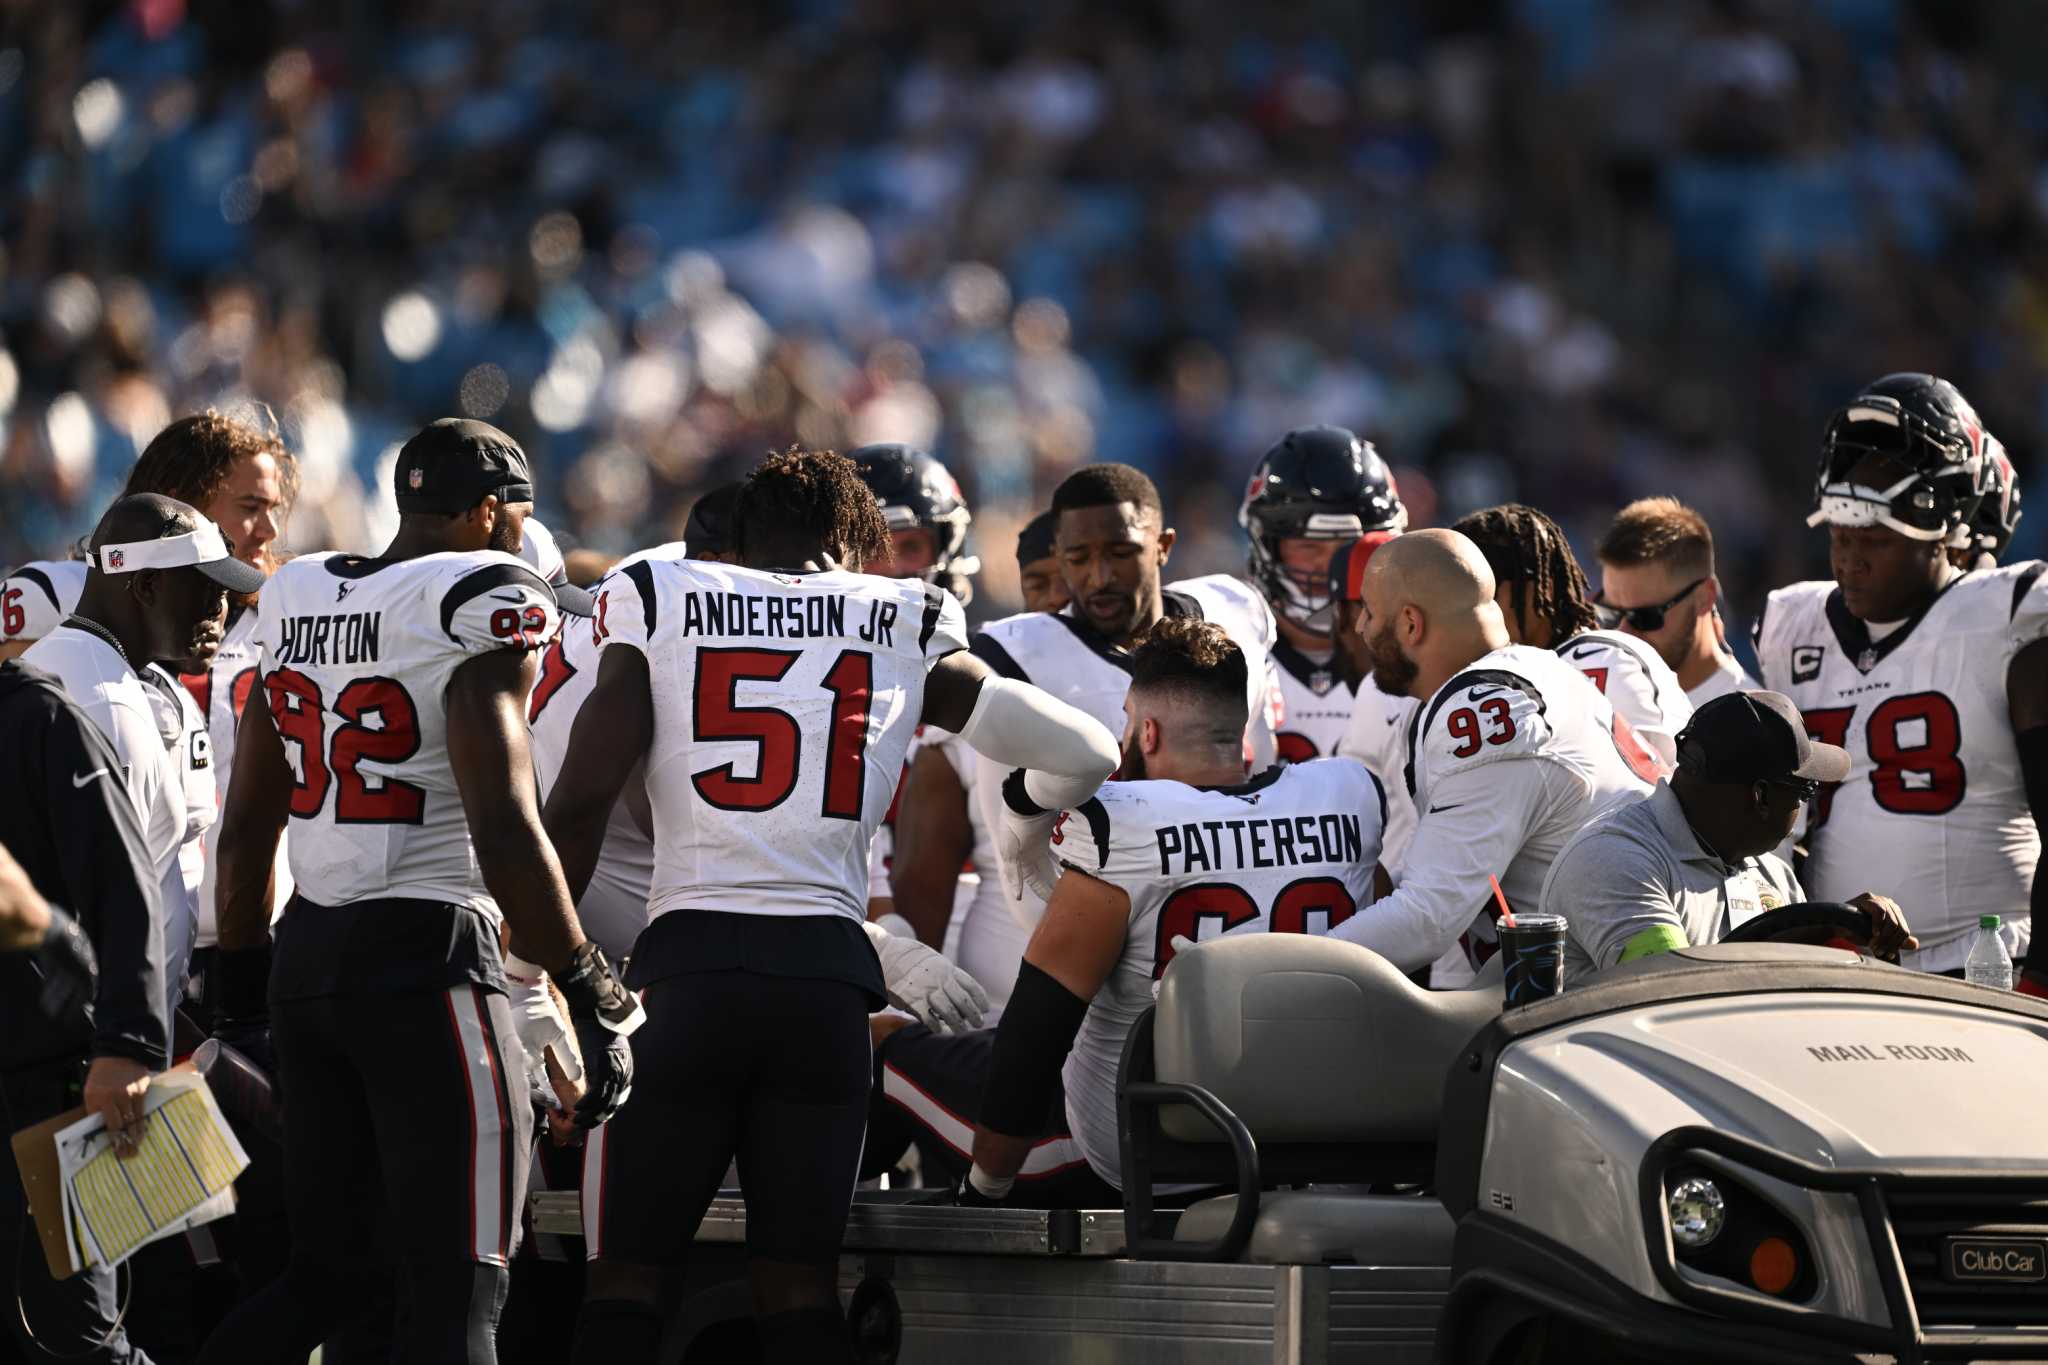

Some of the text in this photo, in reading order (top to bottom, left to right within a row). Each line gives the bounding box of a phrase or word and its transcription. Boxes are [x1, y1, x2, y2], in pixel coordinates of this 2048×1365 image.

[275, 611, 381, 664] HORTON
[683, 591, 898, 647] ANDERSON JR
[264, 665, 427, 824] 92
[691, 646, 873, 821] 51
[1447, 697, 1516, 759] 93
[1800, 690, 1967, 829] 78
[1155, 814, 1362, 876] PATTERSON
[1806, 1045, 1975, 1063] MAIL ROOM
[1962, 1250, 2035, 1271] Club Car
